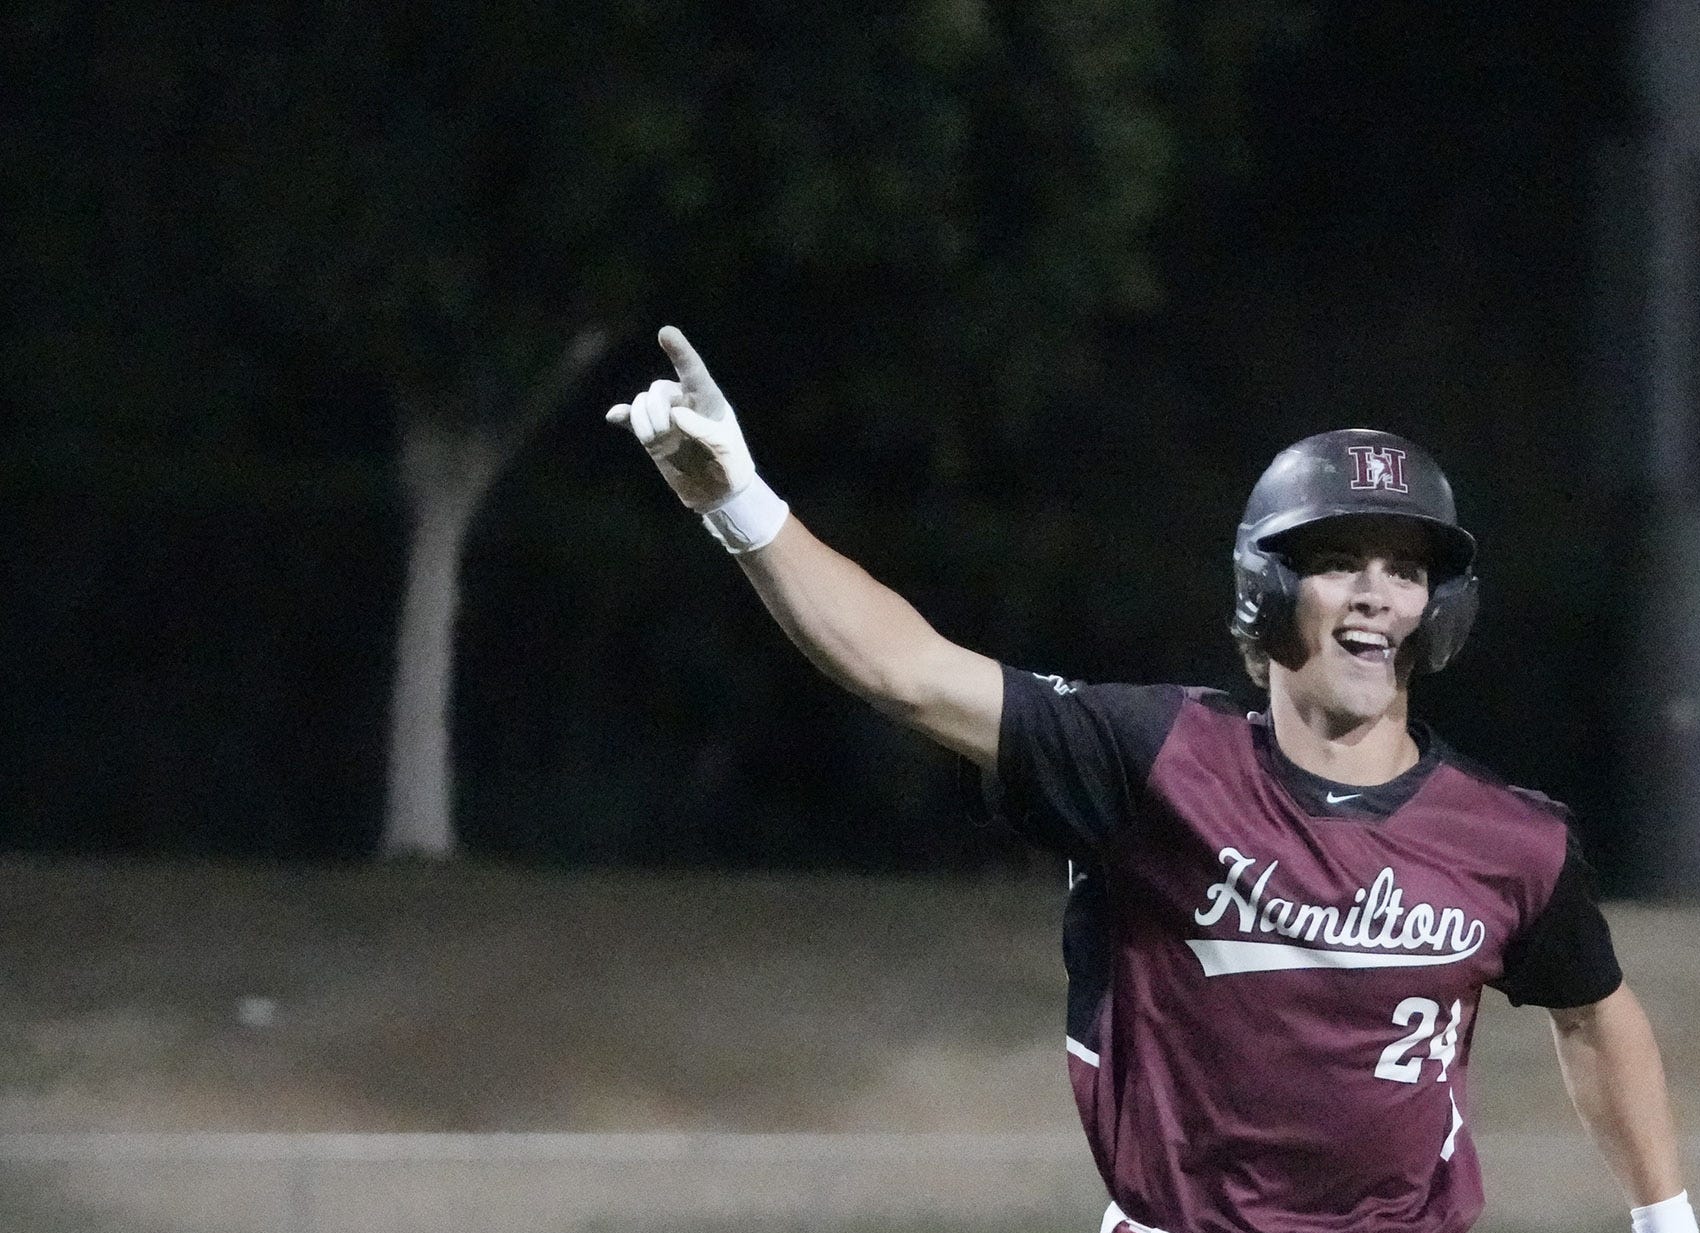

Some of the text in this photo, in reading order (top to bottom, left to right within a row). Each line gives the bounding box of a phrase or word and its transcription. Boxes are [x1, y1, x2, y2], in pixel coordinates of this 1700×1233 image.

[1348, 446, 1408, 494] H
[1194, 846, 1486, 952] Hamilton
[1374, 996, 1461, 1084] 24
